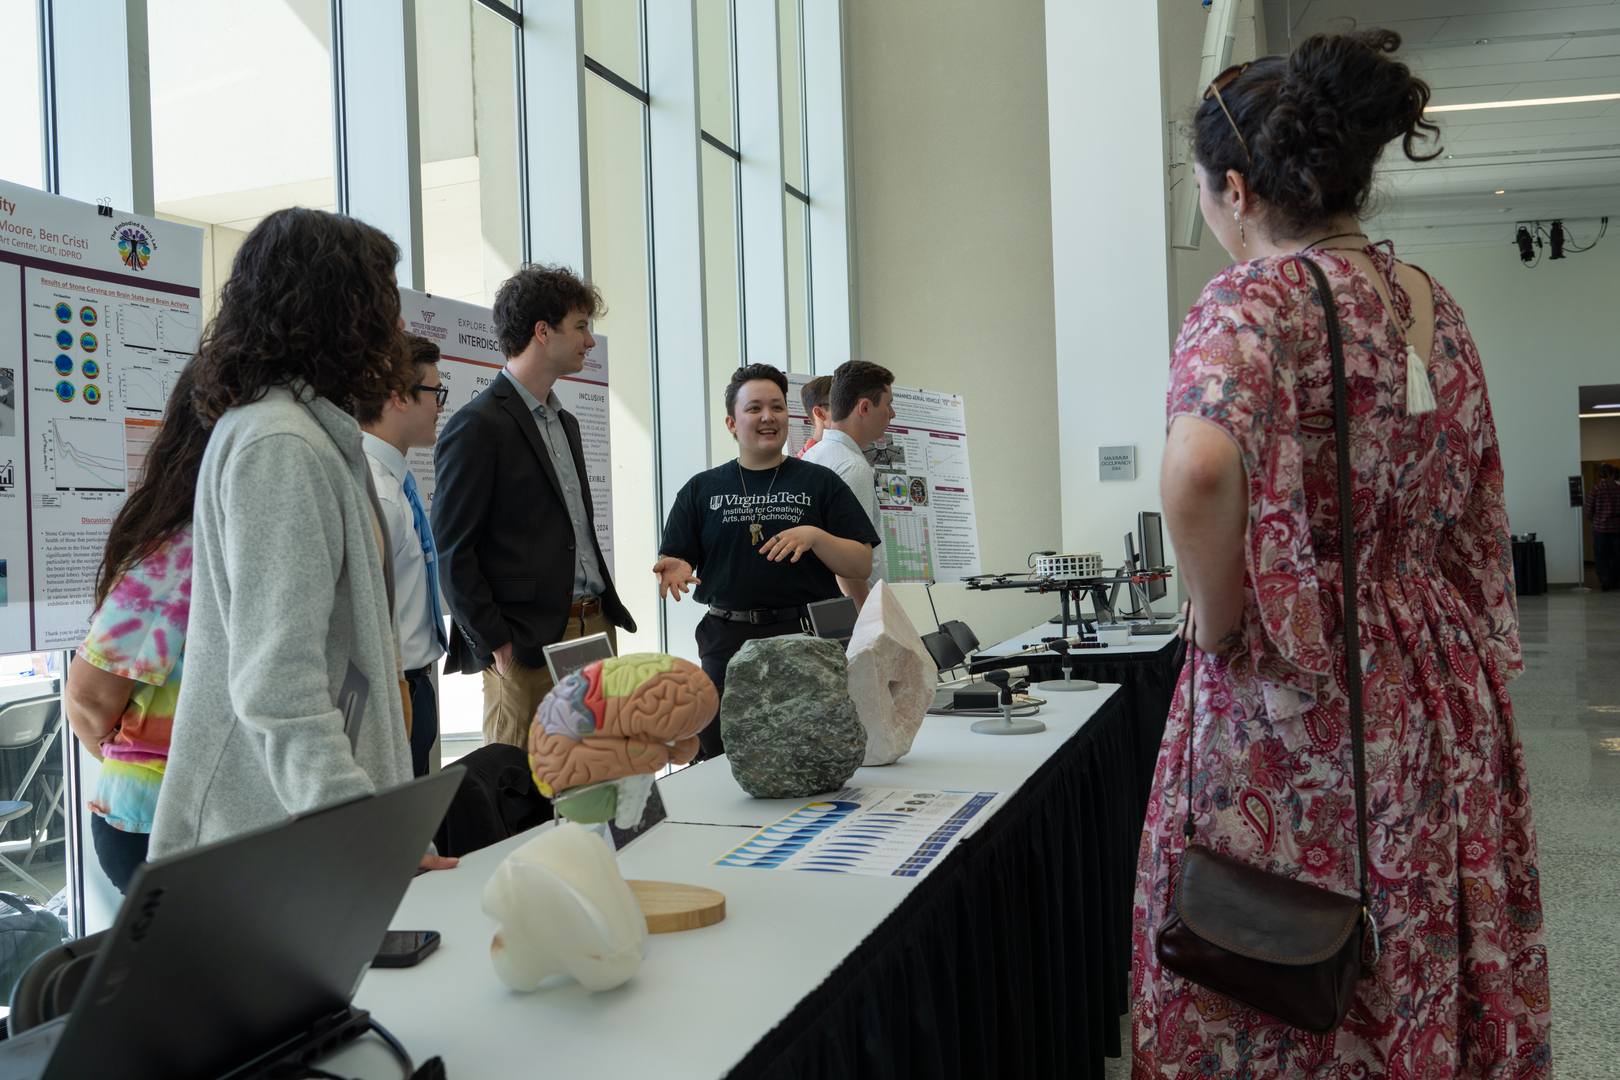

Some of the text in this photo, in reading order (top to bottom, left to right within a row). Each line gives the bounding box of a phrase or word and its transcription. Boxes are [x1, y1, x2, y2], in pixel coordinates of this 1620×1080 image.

[0, 220, 88, 249] Moore, Ben Cristi
[115, 221, 140, 231] Embodied
[141, 225, 152, 238] Brain
[0, 235, 82, 260] Art Center, ICAT, IDPRO
[41, 278, 60, 288] Results
[87, 286, 107, 296] Carving
[156, 297, 169, 305] Brain
[171, 298, 189, 309] Activity
[421, 310, 435, 323] VT
[458, 318, 488, 333] EXPLORE,
[579, 392, 605, 403] INCLUSIVE
[723, 507, 754, 516] Institute
[767, 506, 804, 515] Creativity,
[757, 513, 801, 523] Technology
